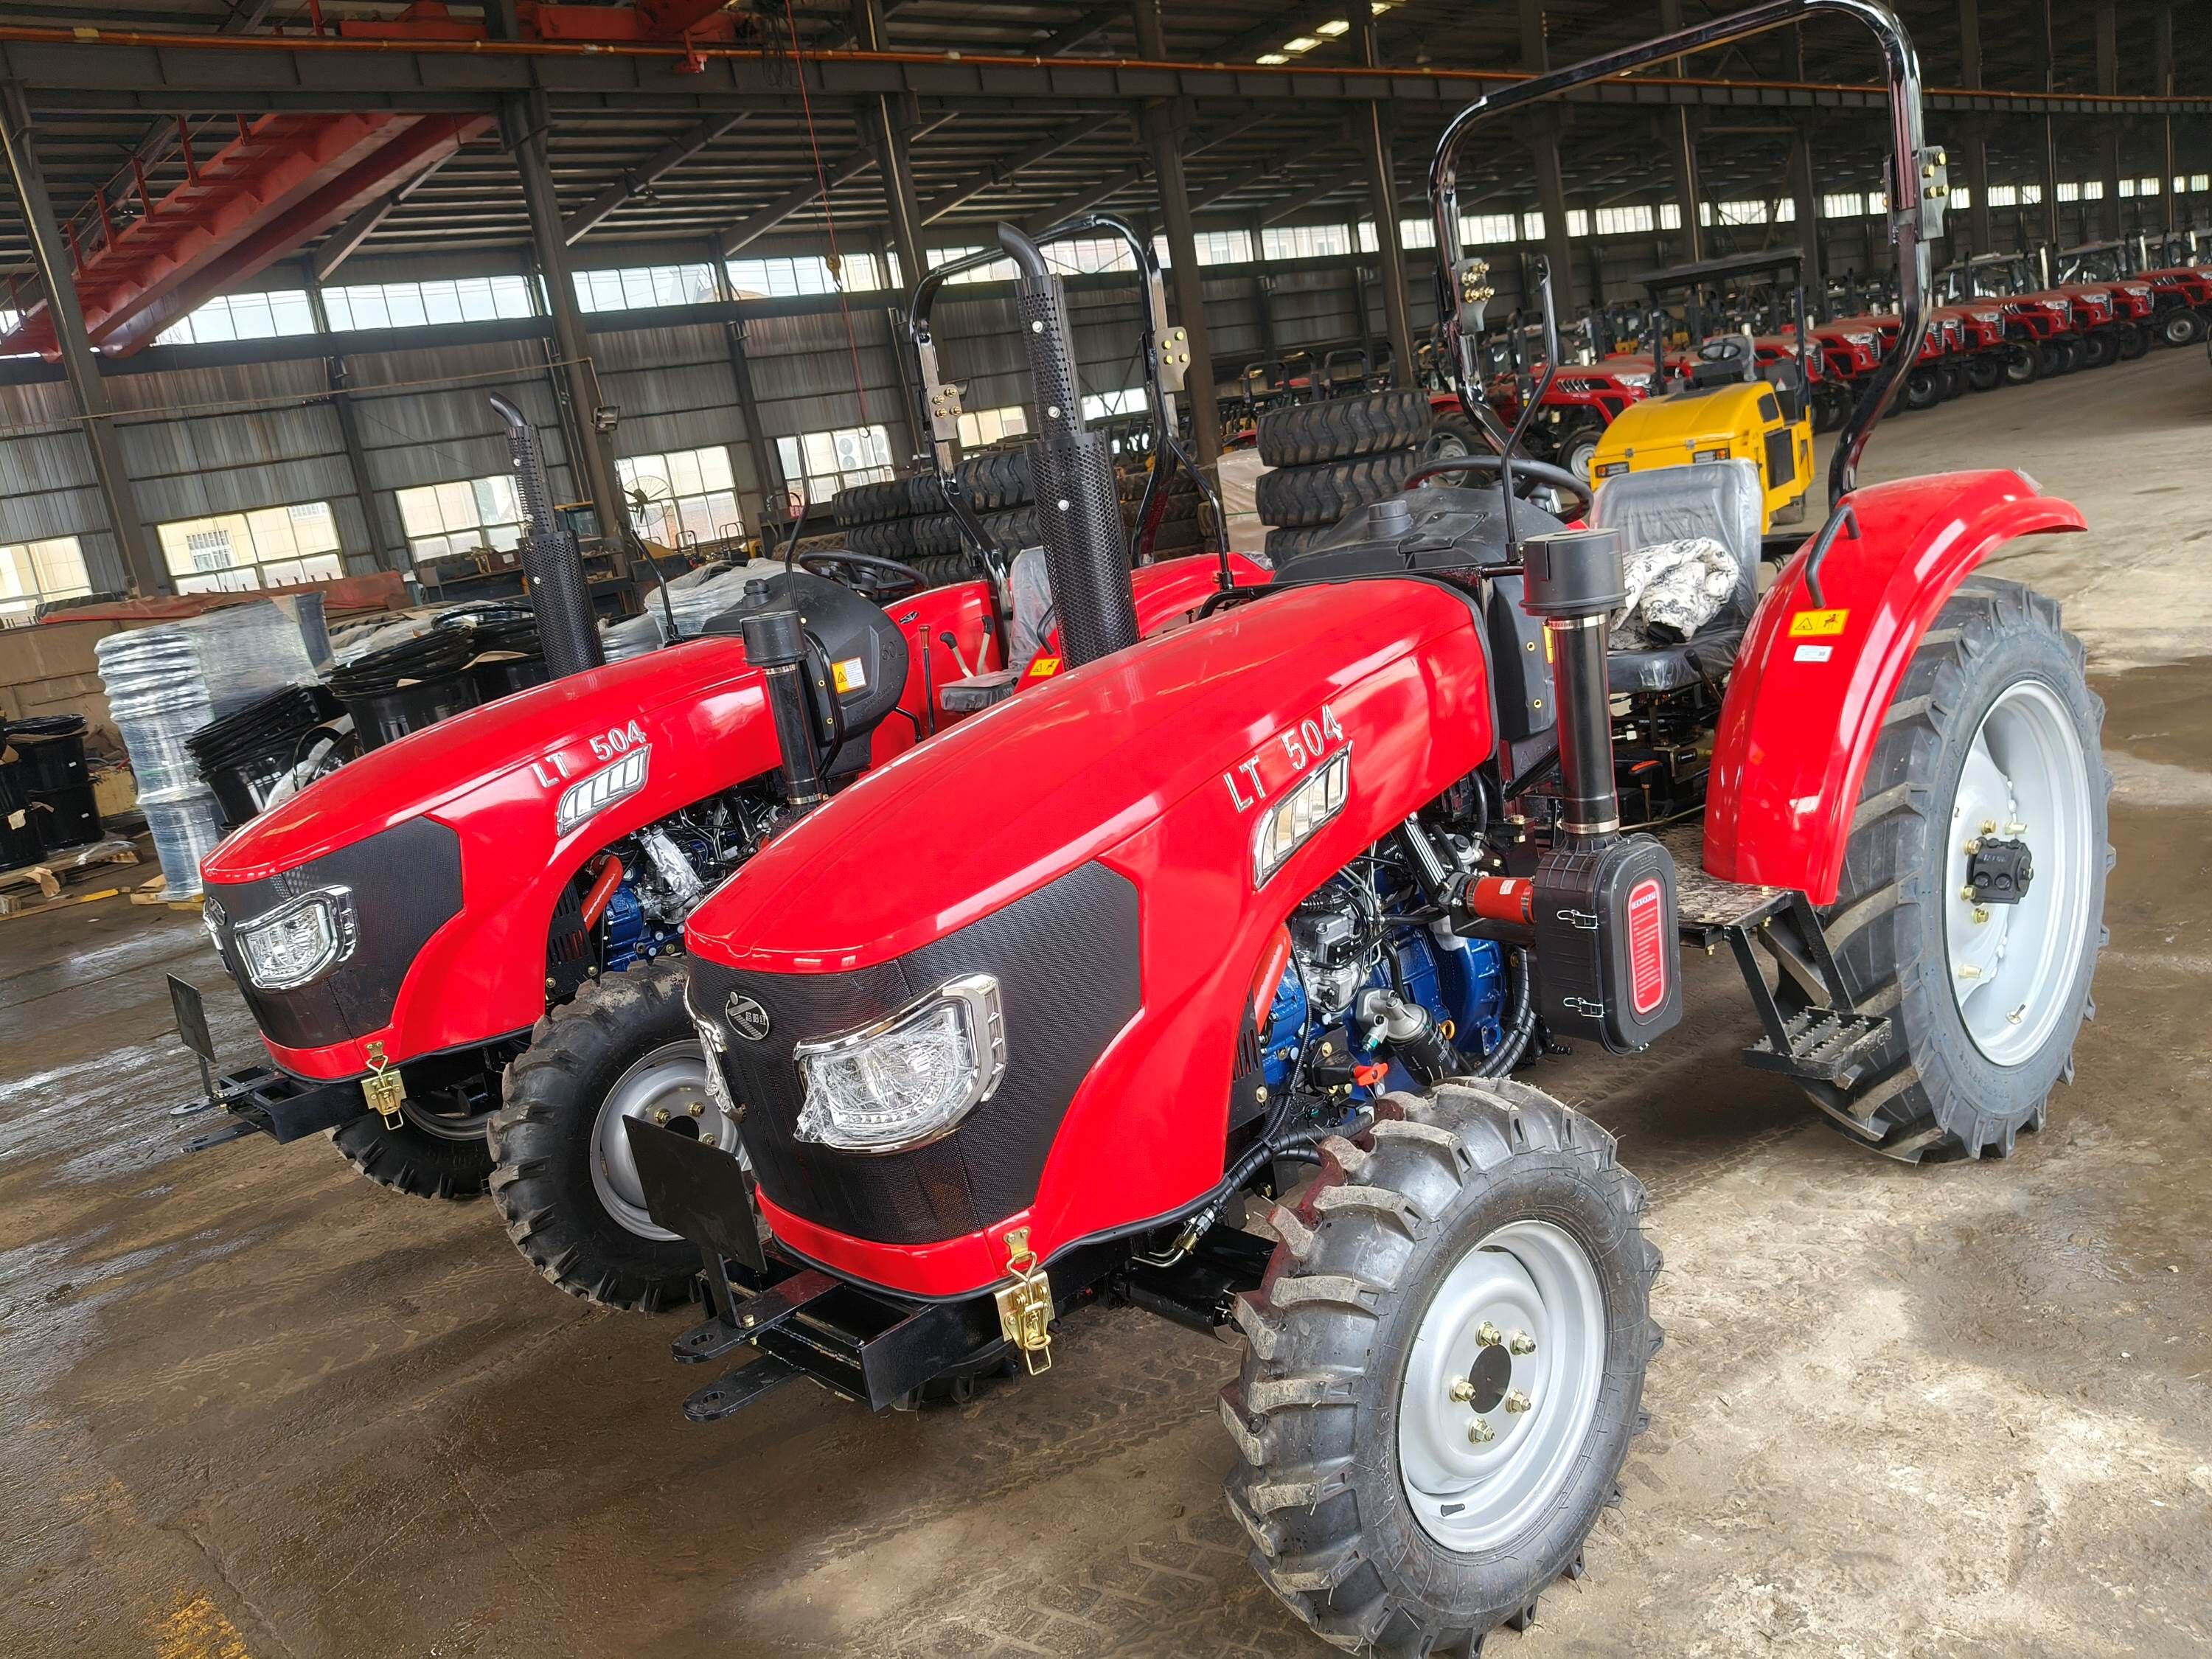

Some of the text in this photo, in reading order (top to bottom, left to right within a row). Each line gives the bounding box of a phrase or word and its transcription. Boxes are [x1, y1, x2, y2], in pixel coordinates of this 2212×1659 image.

[531, 720, 647, 788] LT 504
[1223, 704, 1343, 813] LT 504
